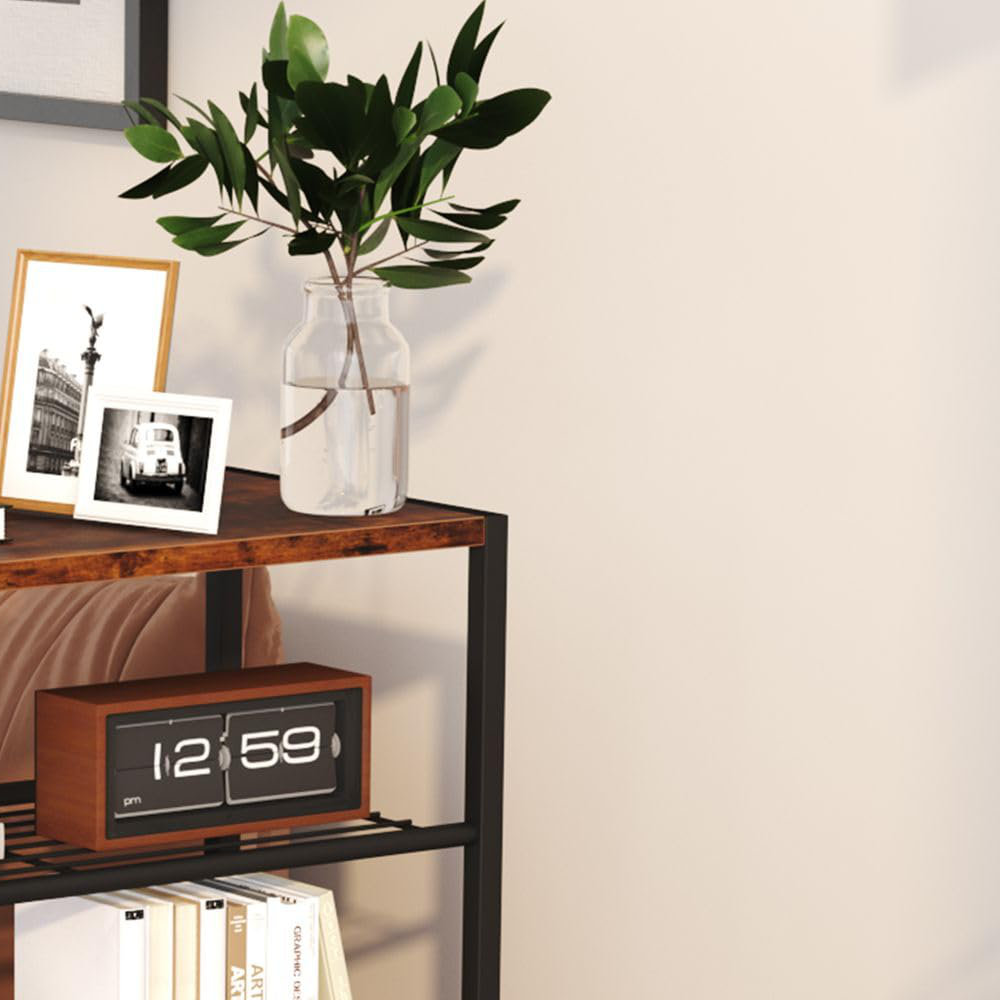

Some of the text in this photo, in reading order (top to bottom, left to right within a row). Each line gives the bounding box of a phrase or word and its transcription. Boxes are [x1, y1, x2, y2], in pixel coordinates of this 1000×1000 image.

[153, 725, 321, 780] 12 59
[123, 795, 142, 807] pm
[293, 925, 302, 977] GRAPHIC
[251, 964, 264, 1000] ART
